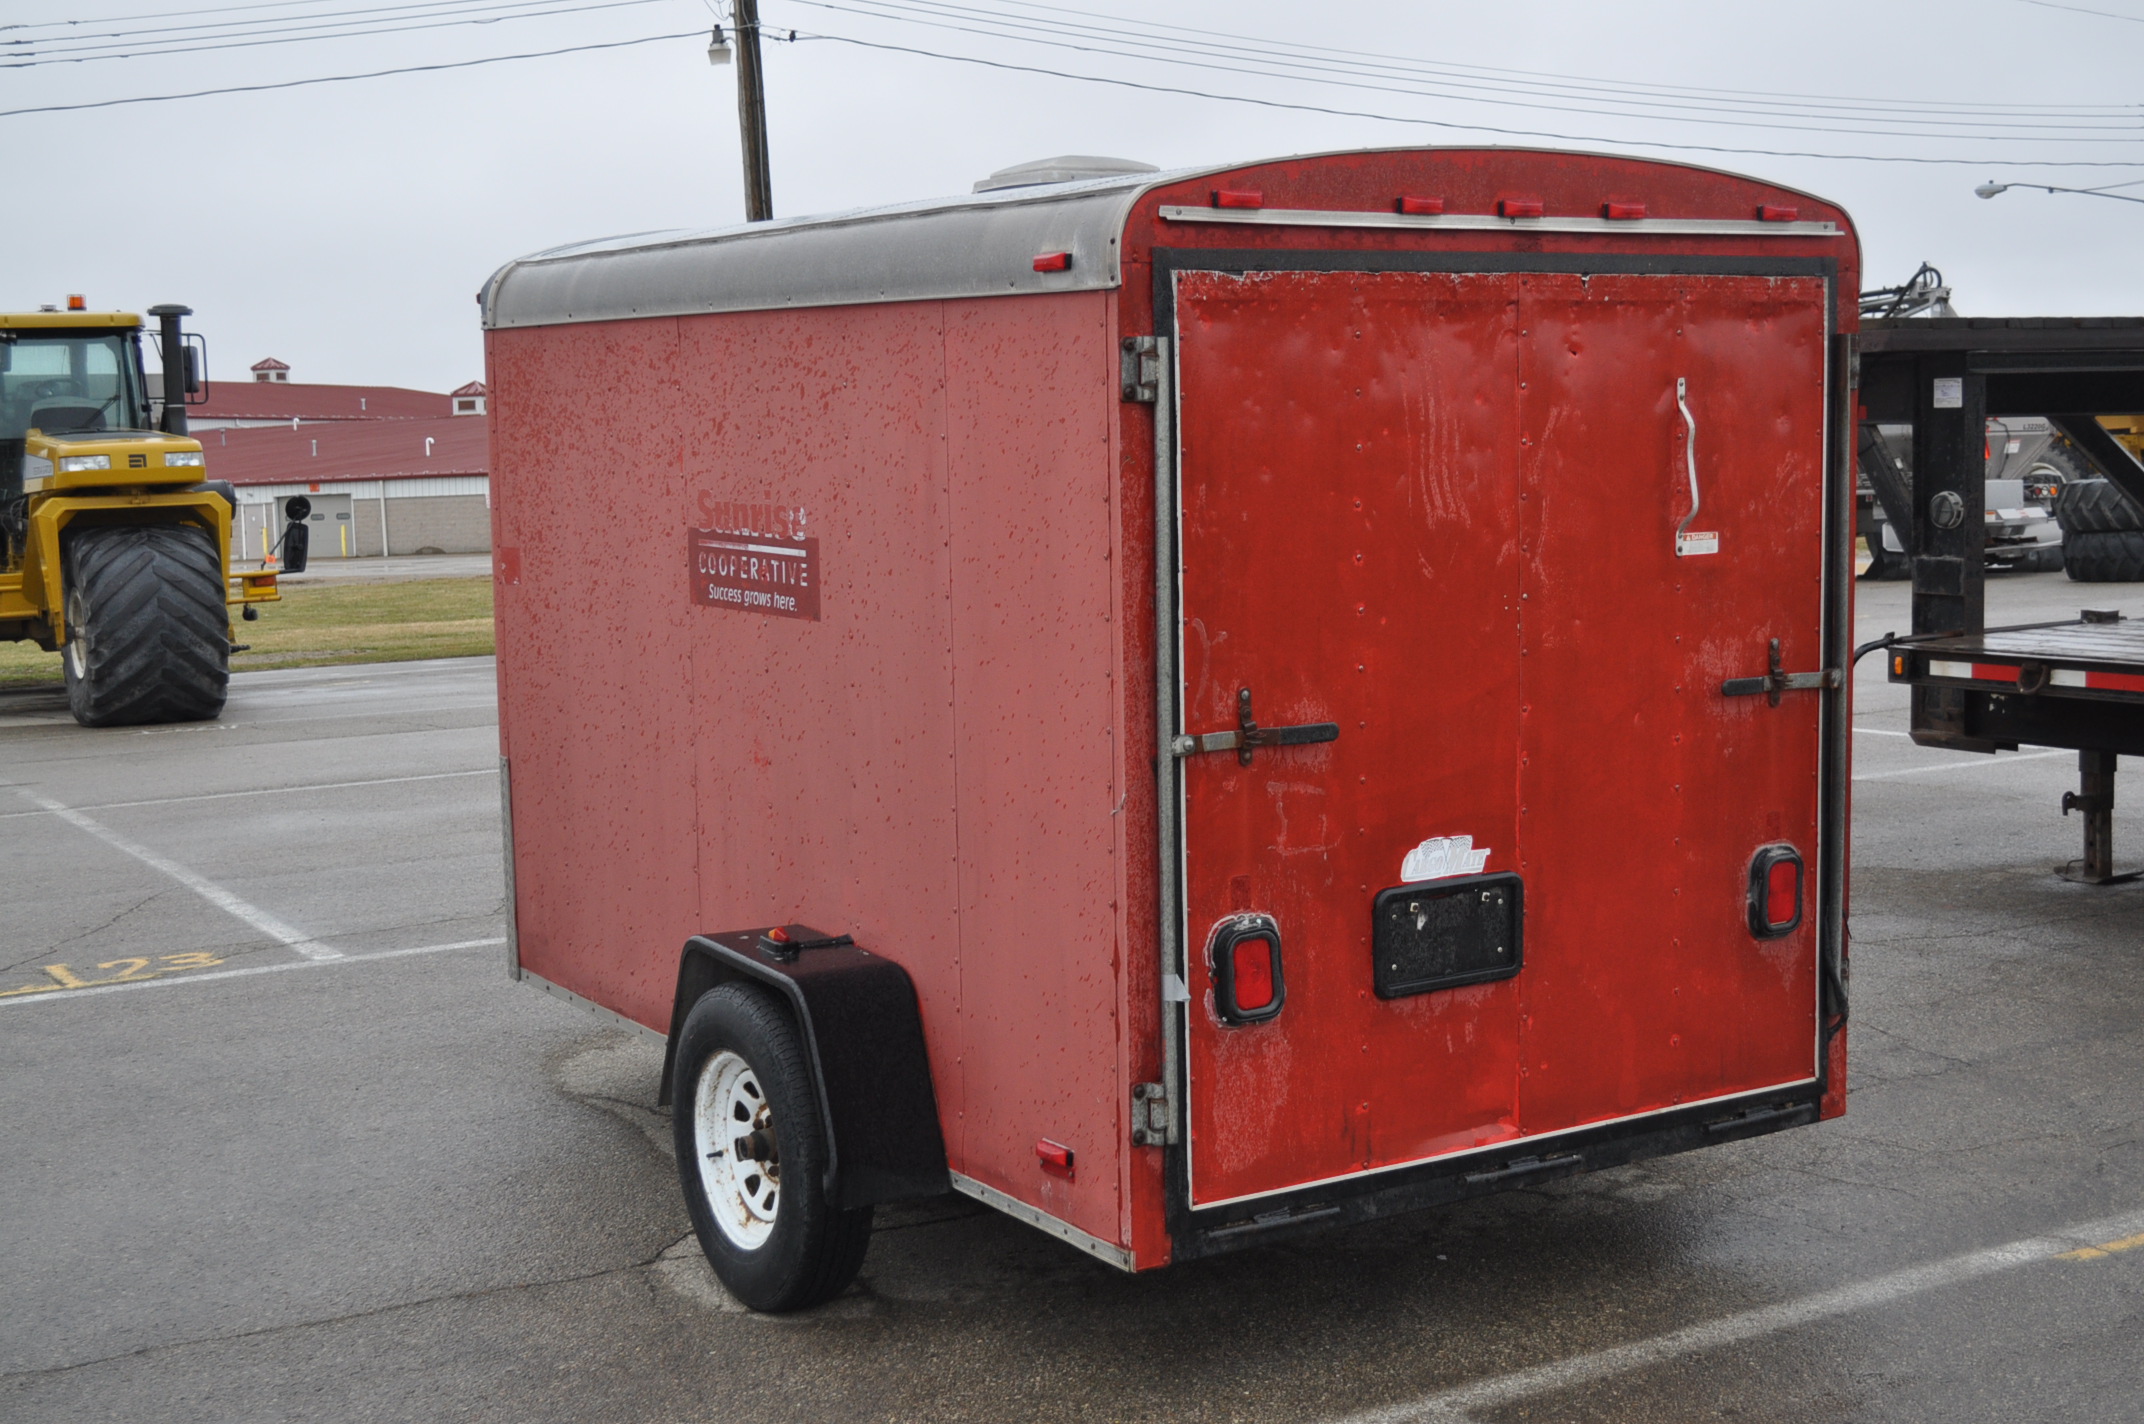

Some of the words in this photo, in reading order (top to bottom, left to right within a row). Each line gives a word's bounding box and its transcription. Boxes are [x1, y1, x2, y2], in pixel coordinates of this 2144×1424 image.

[698, 551, 808, 587] COOPERATIVE
[708, 583, 742, 603] Success
[743, 589, 772, 607] grows
[773, 591, 798, 612] here.
